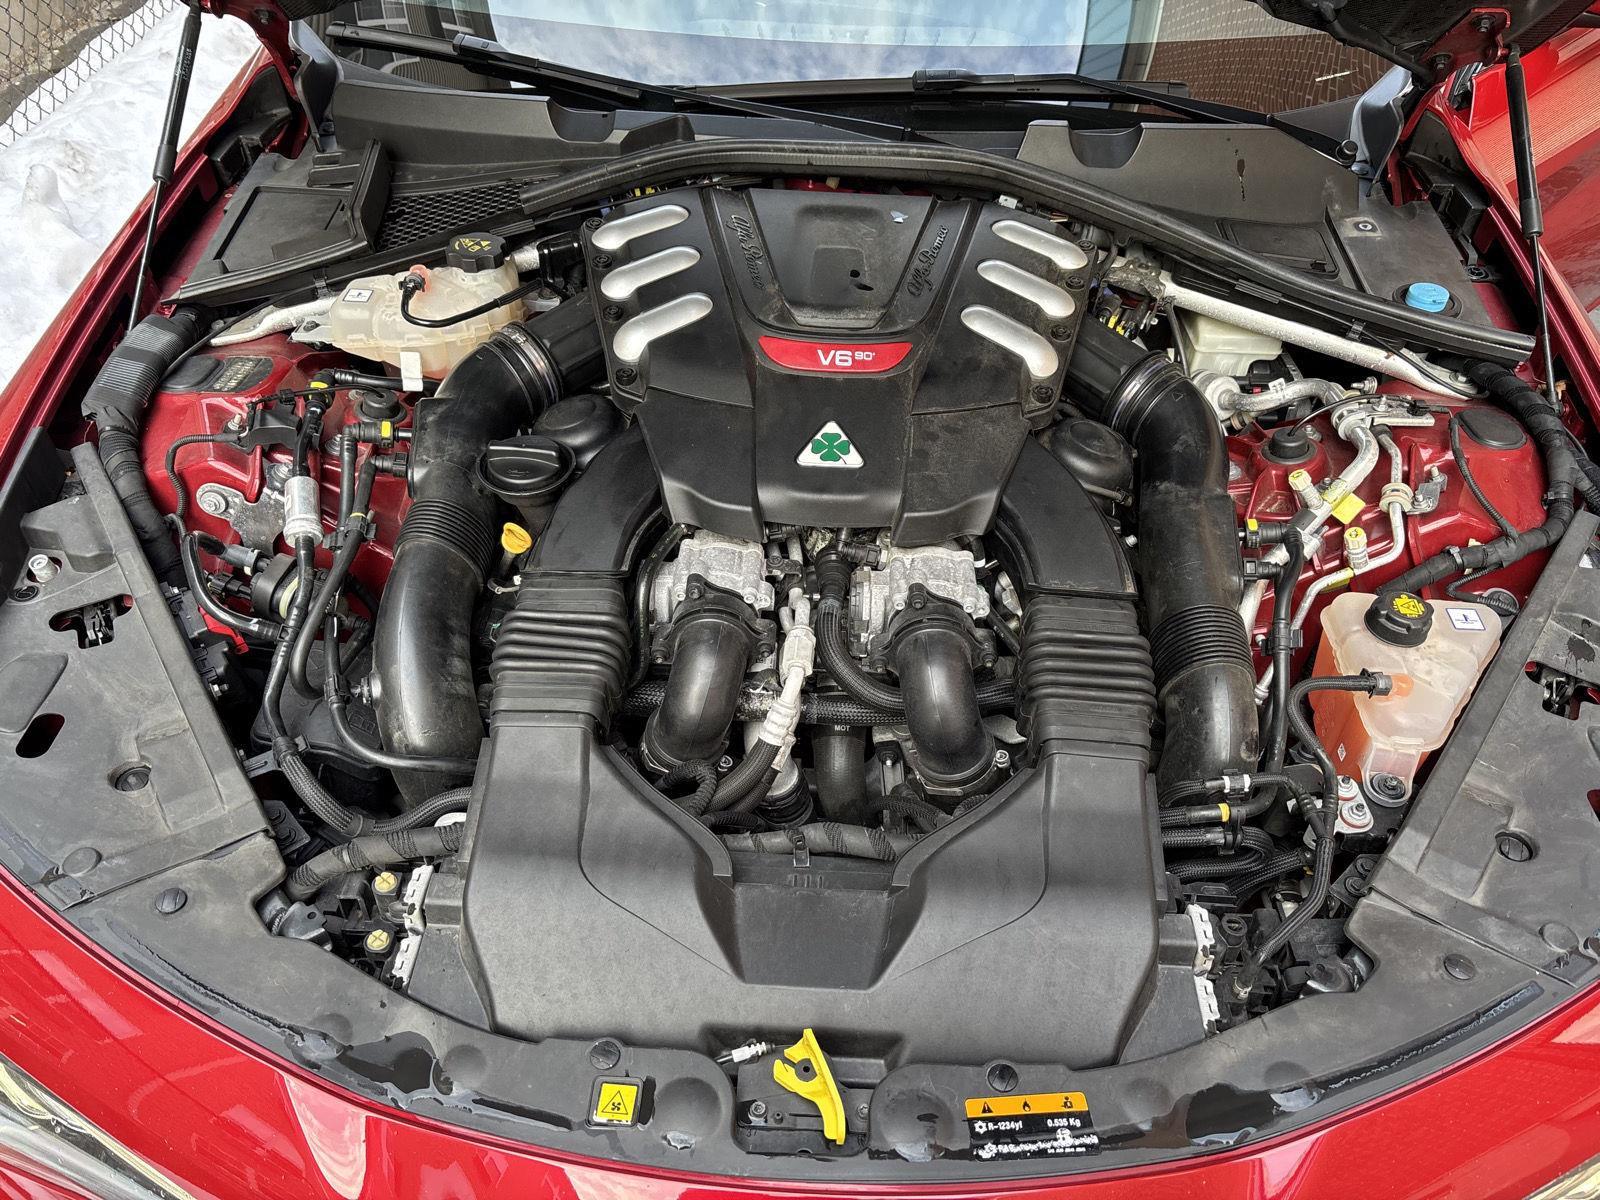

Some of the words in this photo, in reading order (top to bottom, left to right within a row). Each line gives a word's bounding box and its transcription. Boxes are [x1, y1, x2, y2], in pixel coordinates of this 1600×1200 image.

[726, 214, 755, 244] Alfa
[741, 243, 765, 290] Romeo
[918, 224, 949, 267] Romeo
[906, 265, 934, 297] Alfa
[817, 349, 853, 367] V6
[834, 724, 851, 732] MOT
[1046, 1117, 1069, 1128] 0.535
[1068, 1117, 1082, 1128] Kg
